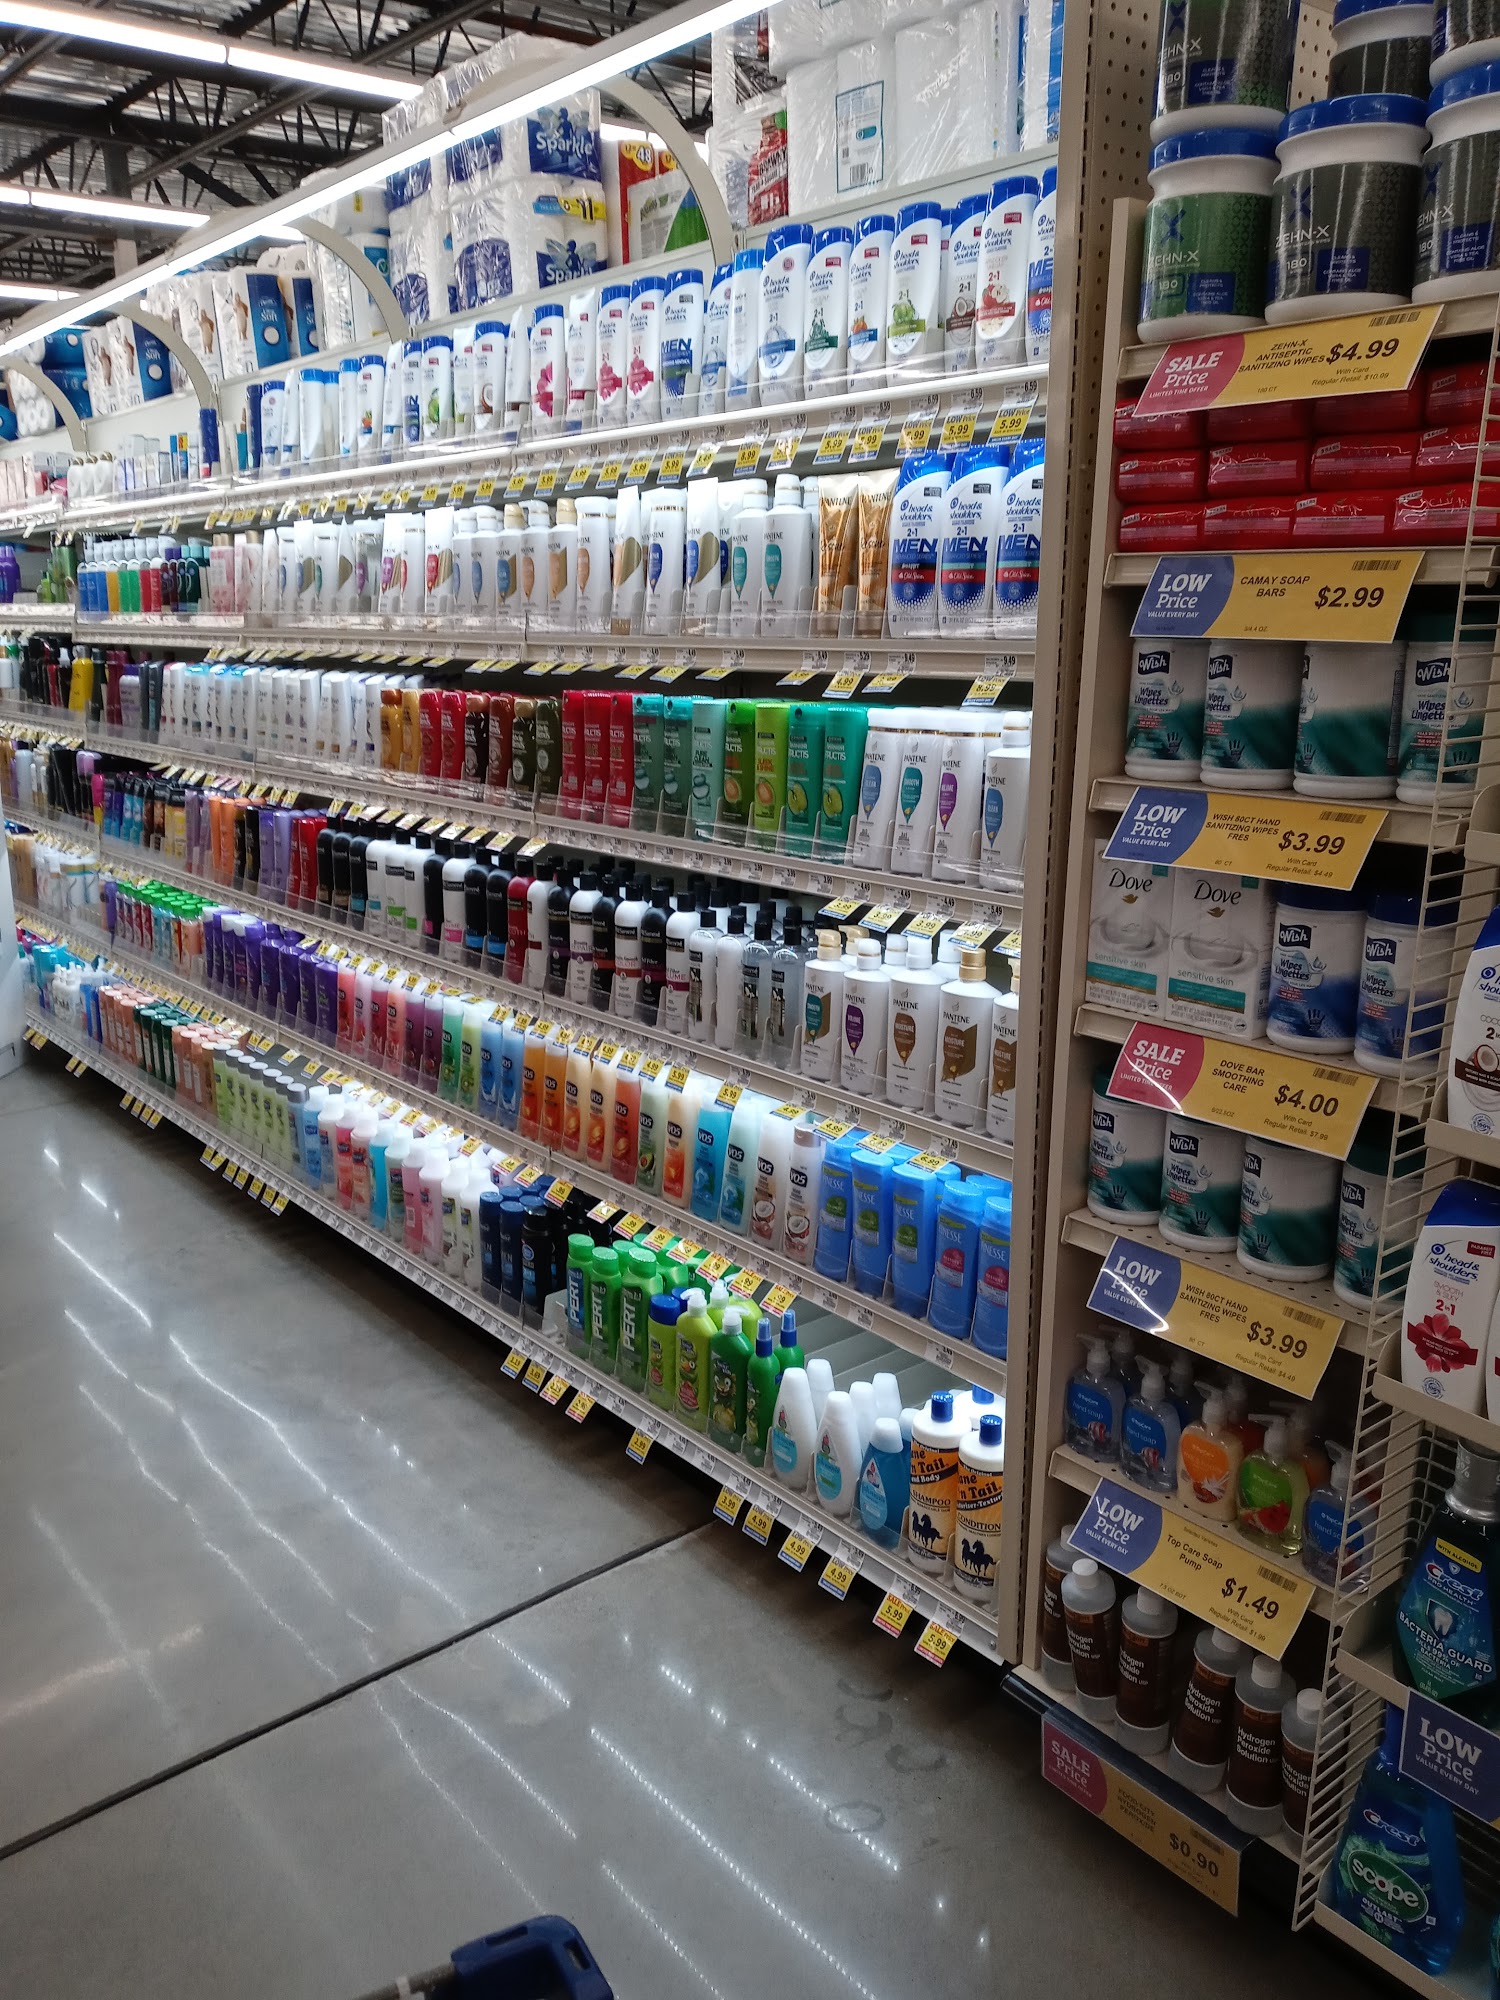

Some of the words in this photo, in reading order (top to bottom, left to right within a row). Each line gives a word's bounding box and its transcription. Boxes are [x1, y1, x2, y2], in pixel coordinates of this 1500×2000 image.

[535, 130, 594, 156] Sparkle
[636, 145, 653, 162] 48
[1285, 256, 1308, 270] 180
[661, 338, 692, 351] MEN
[1270, 339, 1309, 351] ZEHN-X
[1325, 338, 1400, 365] $4.99
[1165, 351, 1223, 374] SALE
[1238, 357, 1292, 373] SANITIZING
[1293, 355, 1325, 367] WIPES
[1256, 348, 1313, 362] ANTISEPTIC
[1162, 370, 1209, 389] Price
[1149, 390, 1175, 399] LIMITED
[1174, 388, 1188, 396] TIME
[1187, 385, 1209, 394] OFFER
[948, 424, 969, 436] 5.99
[999, 418, 1022, 429] 5.99
[893, 538, 938, 553] MEN
[944, 536, 988, 552] MEN
[1157, 573, 1213, 593] LOW
[1240, 576, 1277, 585] CAMAY
[1279, 575, 1311, 585] SOAP
[1155, 592, 1199, 609] Price
[1256, 587, 1286, 598] BARS
[1314, 585, 1385, 609] $2.99
[1147, 611, 1165, 619] VALUE
[1166, 611, 1186, 619] EVERY
[1186, 611, 1199, 619] DAY
[1140, 655, 1168, 672] Wish
[1134, 695, 1168, 708] Lingettes
[1139, 687, 1163, 700] Wipes
[1418, 699, 1446, 712] Wipes
[903, 754, 928, 763] PANTENE
[985, 775, 1006, 785] PANTENE
[1134, 803, 1187, 824] LOW
[1212, 812, 1234, 823] WISH
[1234, 814, 1255, 825] 80CT
[1255, 816, 1281, 827] HAND
[1130, 821, 1171, 839] Price
[1205, 821, 1249, 833] SANITIZING
[1250, 825, 1279, 836] WIPES
[1227, 832, 1249, 842] FRES
[1122, 837, 1140, 845] VALUE
[1140, 838, 1159, 846] EVERY
[1159, 840, 1171, 848] DAY
[1278, 829, 1346, 855] $3.99
[1266, 863, 1289, 874] Regular
[1313, 869, 1334, 879] $4.49
[1286, 857, 1300, 865] With
[1301, 859, 1317, 868] Card
[1109, 867, 1153, 893] Dove
[1194, 879, 1243, 906] Dove
[1279, 926, 1309, 947] Wish
[1366, 941, 1394, 960] Wish
[1274, 964, 1310, 981] Lingettes
[1279, 958, 1303, 973] Wipes
[1176, 969, 1215, 984] sensitive
[1216, 976, 1234, 987] skin
[845, 993, 867, 1005] PANTENE
[893, 998, 919, 1011] PANTENE
[942, 1010, 970, 1025] PANTENE
[993, 1022, 1017, 1037] PANTENE
[1133, 1039, 1185, 1067] SALE
[671, 1070, 685, 1082] 5.99
[1132, 1058, 1174, 1081] Price
[1212, 1068, 1264, 1088] SMOOTHING
[1220, 1060, 1244, 1073] DOVE
[1245, 1065, 1265, 1077] BAR
[1223, 1080, 1248, 1095] CARE
[1273, 1083, 1339, 1117] $4.00
[1263, 1118, 1287, 1131] Regular
[1309, 1129, 1329, 1140] $7.99
[1283, 1114, 1298, 1122] With
[1298, 1117, 1313, 1127] Card
[698, 1130, 713, 1144] VO5
[1170, 1136, 1197, 1153] Wish
[790, 1171, 807, 1185] VO5
[1114, 1256, 1162, 1286] LOW
[1429, 1257, 1479, 1282] shoulders
[1444, 1252, 1480, 1271] head&
[569, 1275, 582, 1322] PERT
[1103, 1288, 1121, 1300] VALUE
[1120, 1293, 1138, 1306] EVERY
[1111, 1277, 1149, 1301] Price
[1185, 1283, 1205, 1297] WISH
[1206, 1289, 1225, 1304] 80CT
[1225, 1298, 1248, 1314] HAND
[590, 1289, 605, 1340] PERT
[1179, 1291, 1221, 1316] SANITIZING
[1220, 1307, 1247, 1324] WIPES
[1199, 1309, 1221, 1324] FRES
[622, 1295, 637, 1352] PERT
[1246, 1319, 1308, 1360] $3.99
[1087, 1406, 1104, 1421] soap
[919, 1458, 945, 1475] Tail
[911, 1490, 951, 1507] SHAMPOO
[968, 1481, 999, 1500] Tail
[751, 1515, 767, 1530] 4.99
[1099, 1497, 1145, 1532] LOW
[1093, 1517, 1131, 1545] Price
[790, 1541, 806, 1556] 4.99
[1085, 1529, 1104, 1545] VALUE
[1102, 1537, 1120, 1553] EVERY
[1117, 1545, 1129, 1556] DAY
[1167, 1533, 1183, 1553] Top
[1182, 1542, 1202, 1560] Care
[1199, 1551, 1224, 1572] Soap
[1179, 1551, 1203, 1573] Pump
[1437, 1541, 1453, 1557] WITH
[1451, 1549, 1478, 1570] ALCOHOL
[830, 1567, 847, 1583] 4.99
[1425, 1562, 1484, 1602] Crest
[1221, 1577, 1280, 1621] $1.49
[1427, 1575, 1441, 1589] PRO
[1440, 1583, 1474, 1606] HEALTH
[885, 1604, 904, 1622] 5.99
[1227, 1606, 1241, 1618] With
[1240, 1613, 1255, 1626] Card
[927, 1634, 947, 1651] 5.99
[1399, 1610, 1445, 1654] BACTERIA
[1447, 1647, 1493, 1674] GUARD
[1186, 1688, 1215, 1715] Peroxide
[1187, 1680, 1221, 1708] Hydrogen
[1185, 1695, 1211, 1723] Solution
[1236, 1735, 1271, 1756] Peroxide
[1237, 1725, 1276, 1749] Hydrogen
[1419, 1716, 1483, 1767] LOW
[1051, 1740, 1090, 1778] SALE
[1236, 1745, 1268, 1764] Solution
[1422, 1741, 1474, 1783] Price
[1056, 1756, 1088, 1789] Price
[1415, 1754, 1439, 1774] VALUE
[1438, 1766, 1464, 1787] EVERY
[1462, 1781, 1479, 1796] DAY
[1362, 1808, 1420, 1848] Crest
[1168, 1831, 1219, 1879] $0.90
[1351, 1857, 1421, 1908] scope
[1361, 1896, 1399, 1924] OUTLAST
